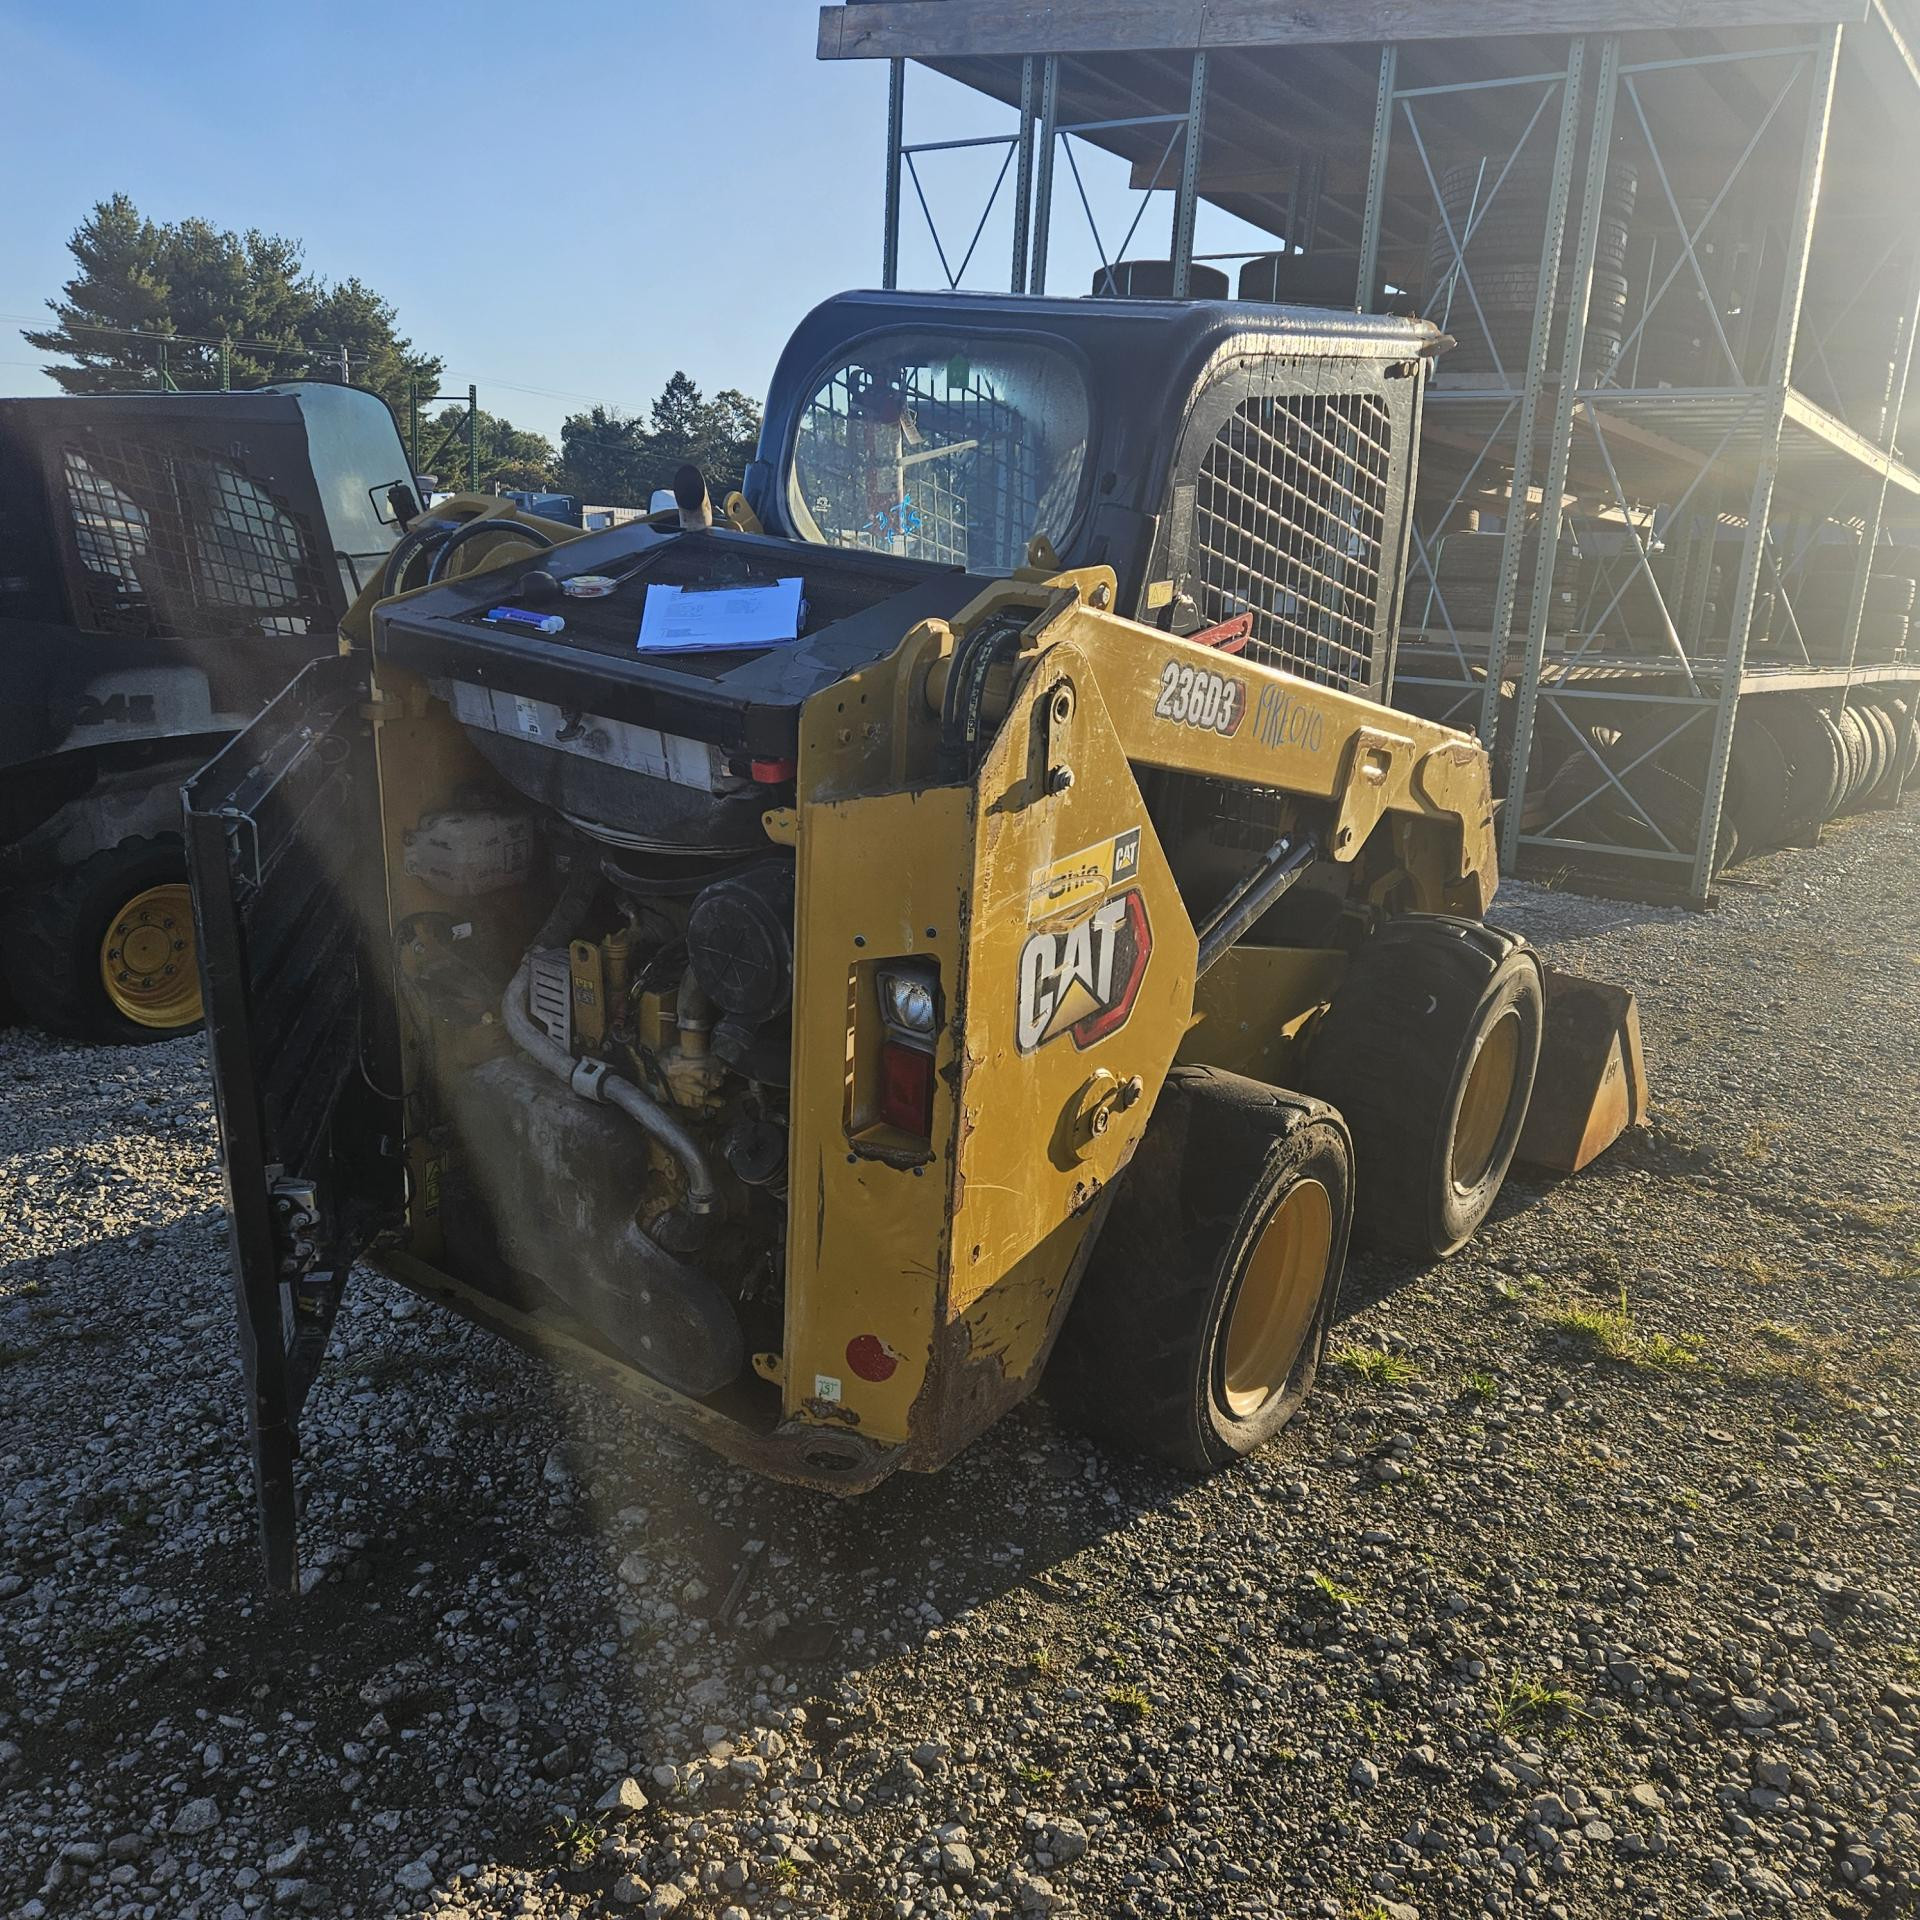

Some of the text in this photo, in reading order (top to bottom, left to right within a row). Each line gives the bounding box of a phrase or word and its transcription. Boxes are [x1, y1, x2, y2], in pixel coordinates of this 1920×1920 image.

[1156, 662, 1237, 731] 236D3
[1115, 841, 1138, 872] CAT
[1018, 896, 1127, 1049] CAT
